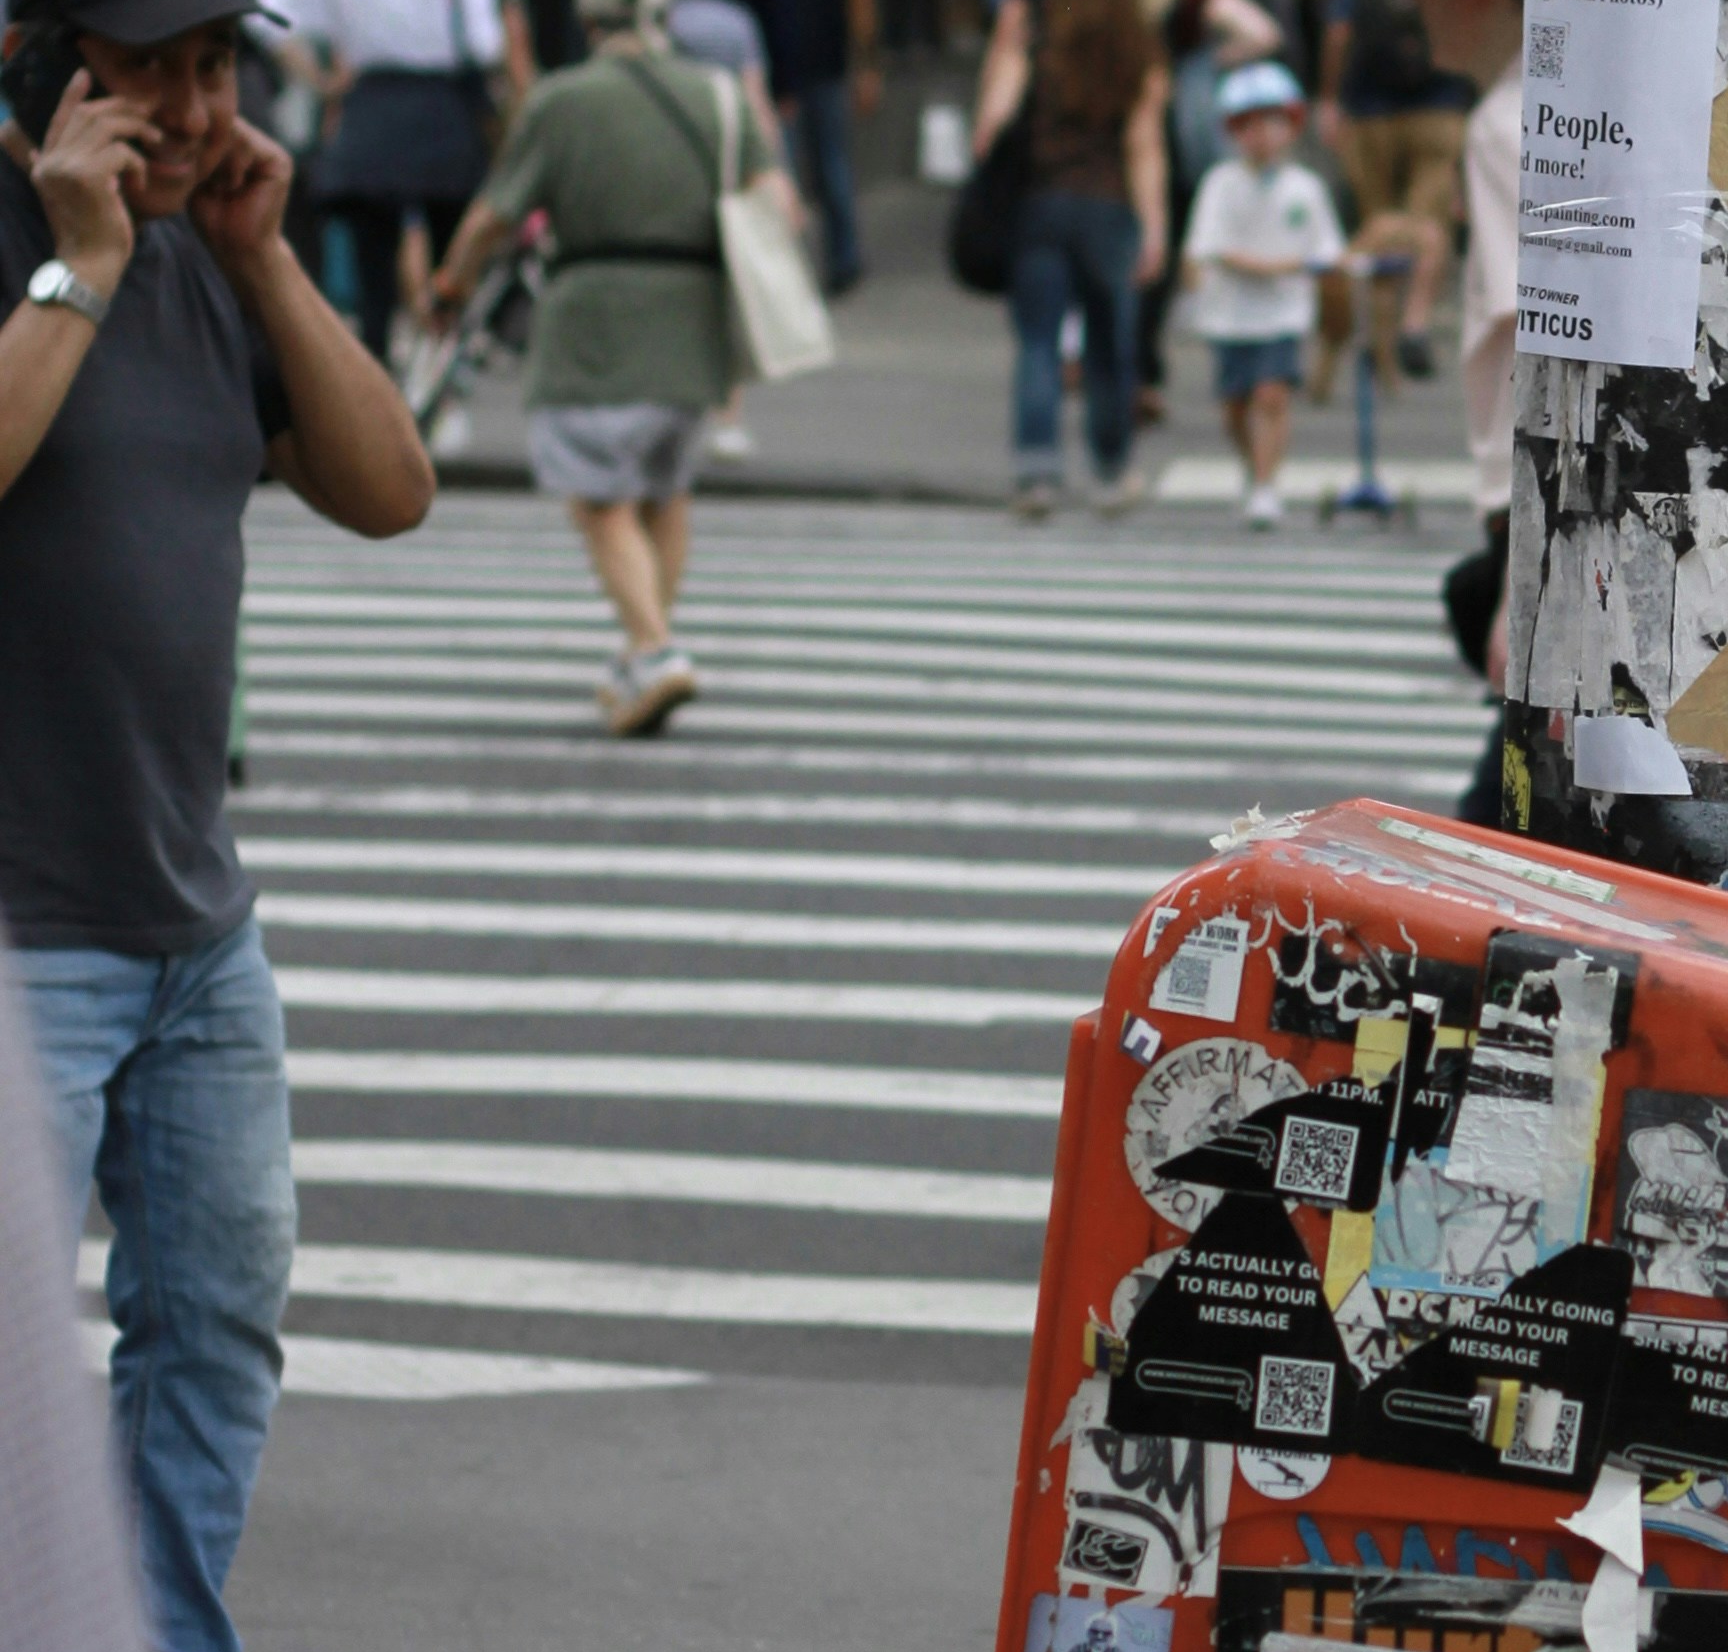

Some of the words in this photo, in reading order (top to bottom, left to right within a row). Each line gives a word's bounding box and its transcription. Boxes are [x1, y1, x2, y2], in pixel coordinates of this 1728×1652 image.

[1537, 104, 1633, 151] People,
[1534, 157, 1586, 180] more!
[1328, 1081, 1384, 1106] 11PM.
[1195, 1251, 1295, 1277] ACTUALLY
[1177, 1275, 1203, 1294] TO
[1206, 1278, 1259, 1300] READ
[1264, 1285, 1317, 1307] YOUR
[1199, 1304, 1290, 1331] MESSAGE
[1551, 1300, 1615, 1327] GOING
[1516, 1321, 1569, 1345] YOUR
[1449, 1336, 1541, 1368] MESSAGE
[1672, 1363, 1698, 1384] TO
